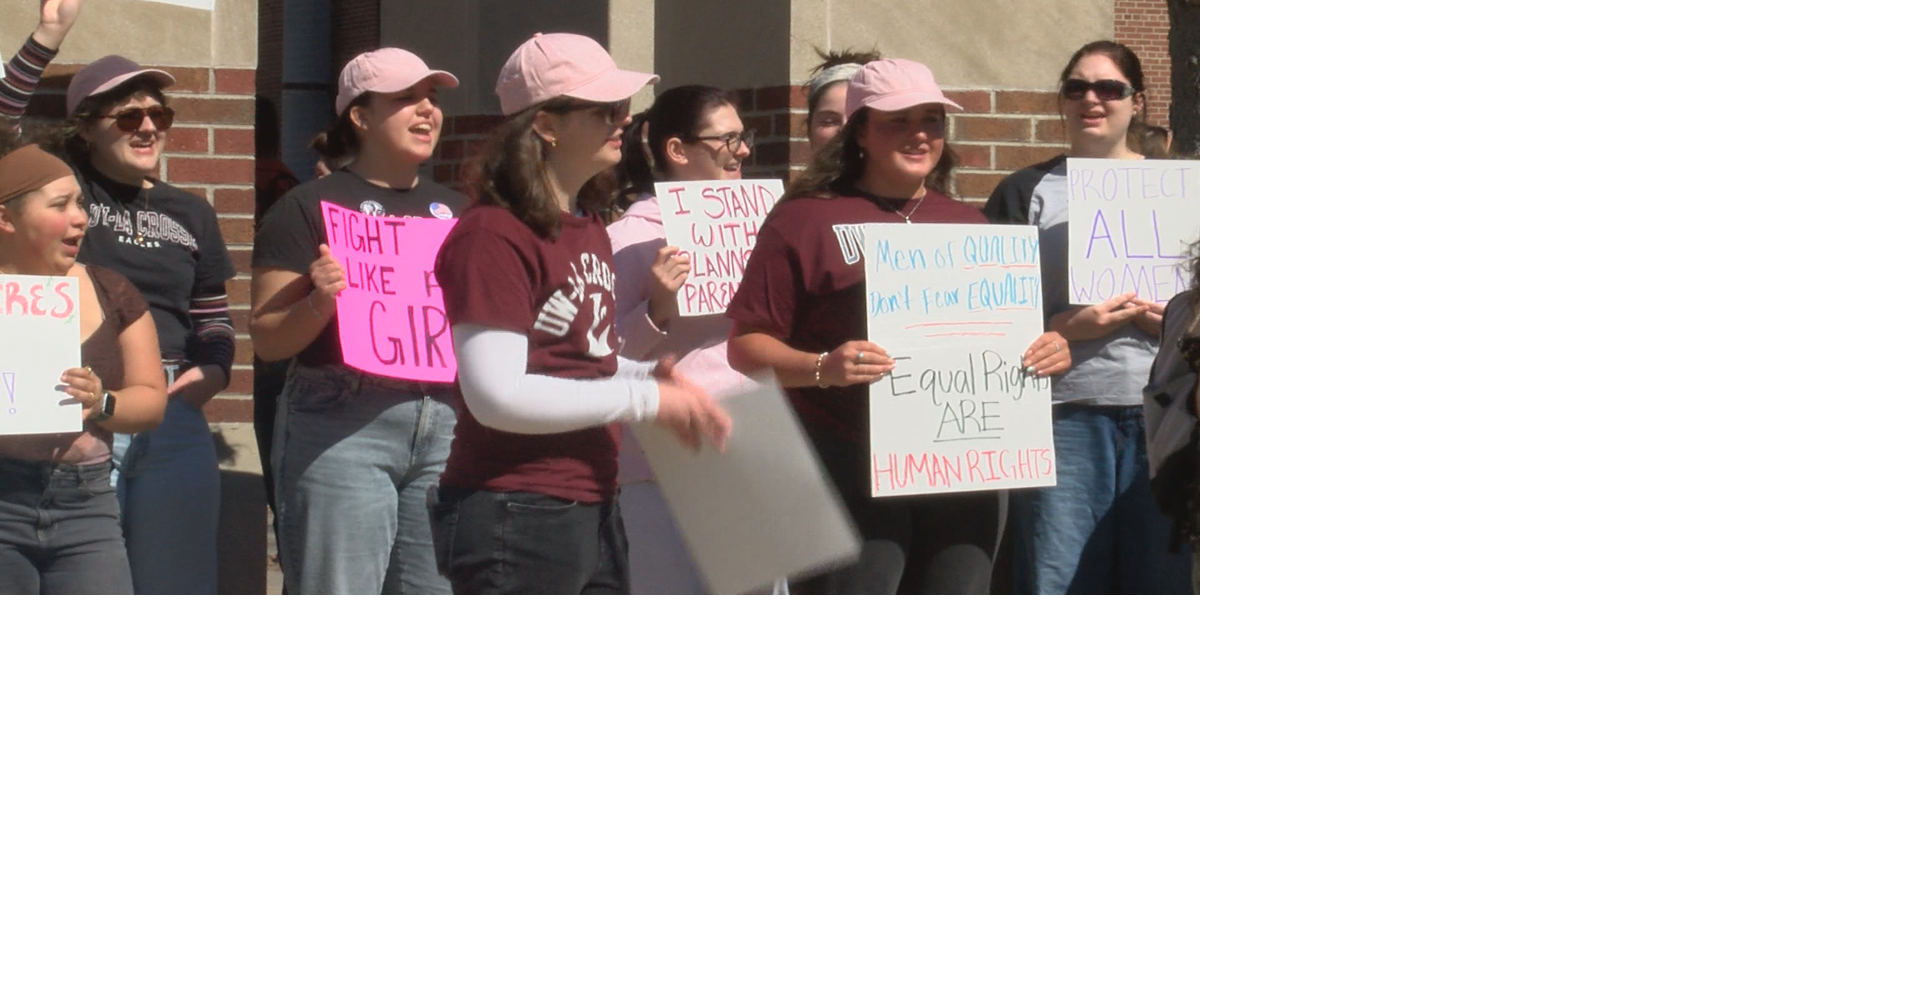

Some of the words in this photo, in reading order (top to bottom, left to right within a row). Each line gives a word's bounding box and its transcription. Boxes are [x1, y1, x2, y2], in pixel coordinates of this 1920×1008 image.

[668, 186, 690, 215] I
[702, 184, 776, 219] STAND
[1070, 168, 1191, 201] PROTECT
[328, 207, 406, 255] FIGHT
[692, 221, 757, 247] WITH
[1086, 209, 1188, 259] ALL
[876, 239, 926, 272] Men
[934, 241, 954, 268] of
[963, 235, 1039, 264] QUALITY
[346, 258, 396, 295] LIKE
[870, 284, 912, 317] Don't
[967, 273, 1040, 310] EQUALITY
[0, 282, 74, 318] RES
[890, 353, 976, 406] Equal
[936, 399, 1004, 439] ARE
[873, 452, 962, 495] HUMAN
[966, 449, 1052, 483] RIGHTS
